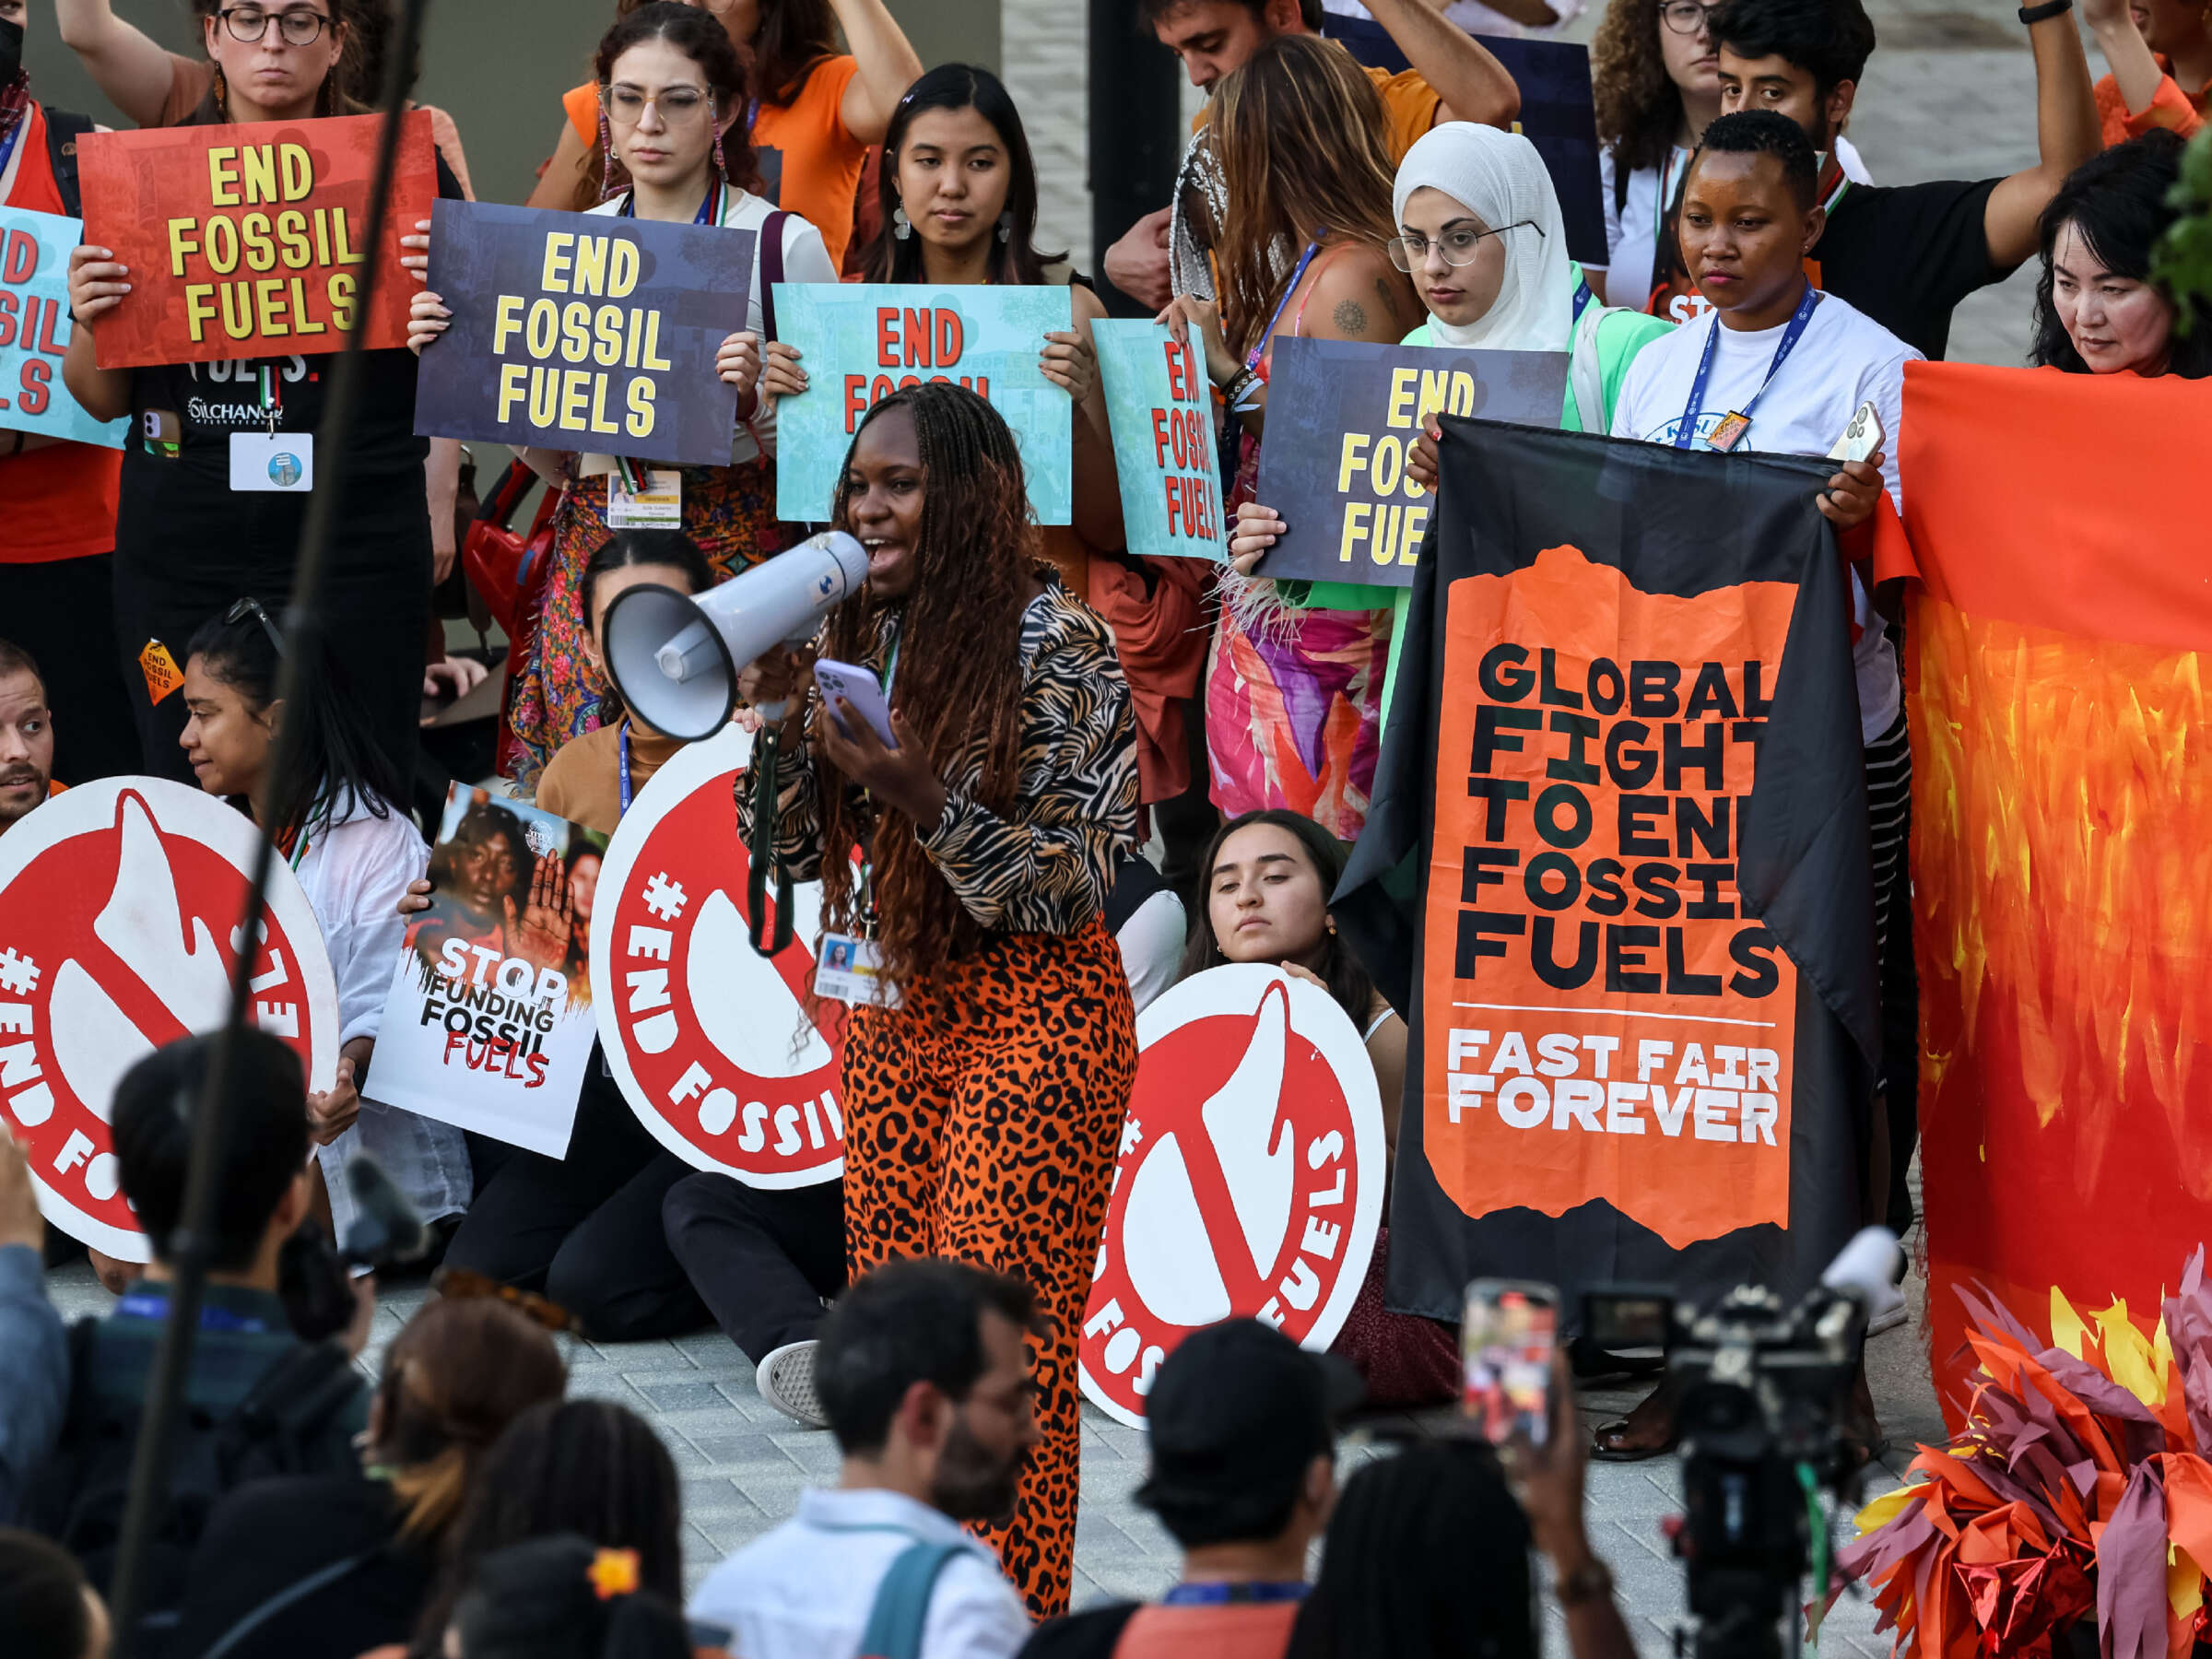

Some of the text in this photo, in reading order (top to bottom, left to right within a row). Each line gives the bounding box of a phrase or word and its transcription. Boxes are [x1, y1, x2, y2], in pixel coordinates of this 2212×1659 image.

[207, 143, 314, 206] END
[168, 206, 366, 276] FOSSIL
[541, 231, 641, 299] END
[185, 273, 359, 342] FUELS
[493, 294, 671, 371] FOSSIL
[877, 307, 963, 368] END
[1669, 294, 1712, 324] ST
[497, 362, 656, 438] FUELS
[1164, 341, 1200, 403] EN
[1386, 367, 1475, 429] END
[1339, 502, 1428, 566] FUE
[148, 653, 166, 665] END
[1478, 642, 1774, 719] GLOBAL
[1467, 776, 1751, 859] TO EN
[1461, 845, 1762, 920] FOSSI
[435, 937, 569, 1004] STOP
[626, 871, 688, 1054] #END
[1454, 910, 1780, 998] FUELS
[0, 947, 55, 1126] #END
[429, 974, 554, 1032] FUNDING
[443, 1031, 550, 1088] FUELS
[1447, 1028, 1780, 1092] FAST FAIR
[1447, 1072, 1779, 1147] FOREVER
